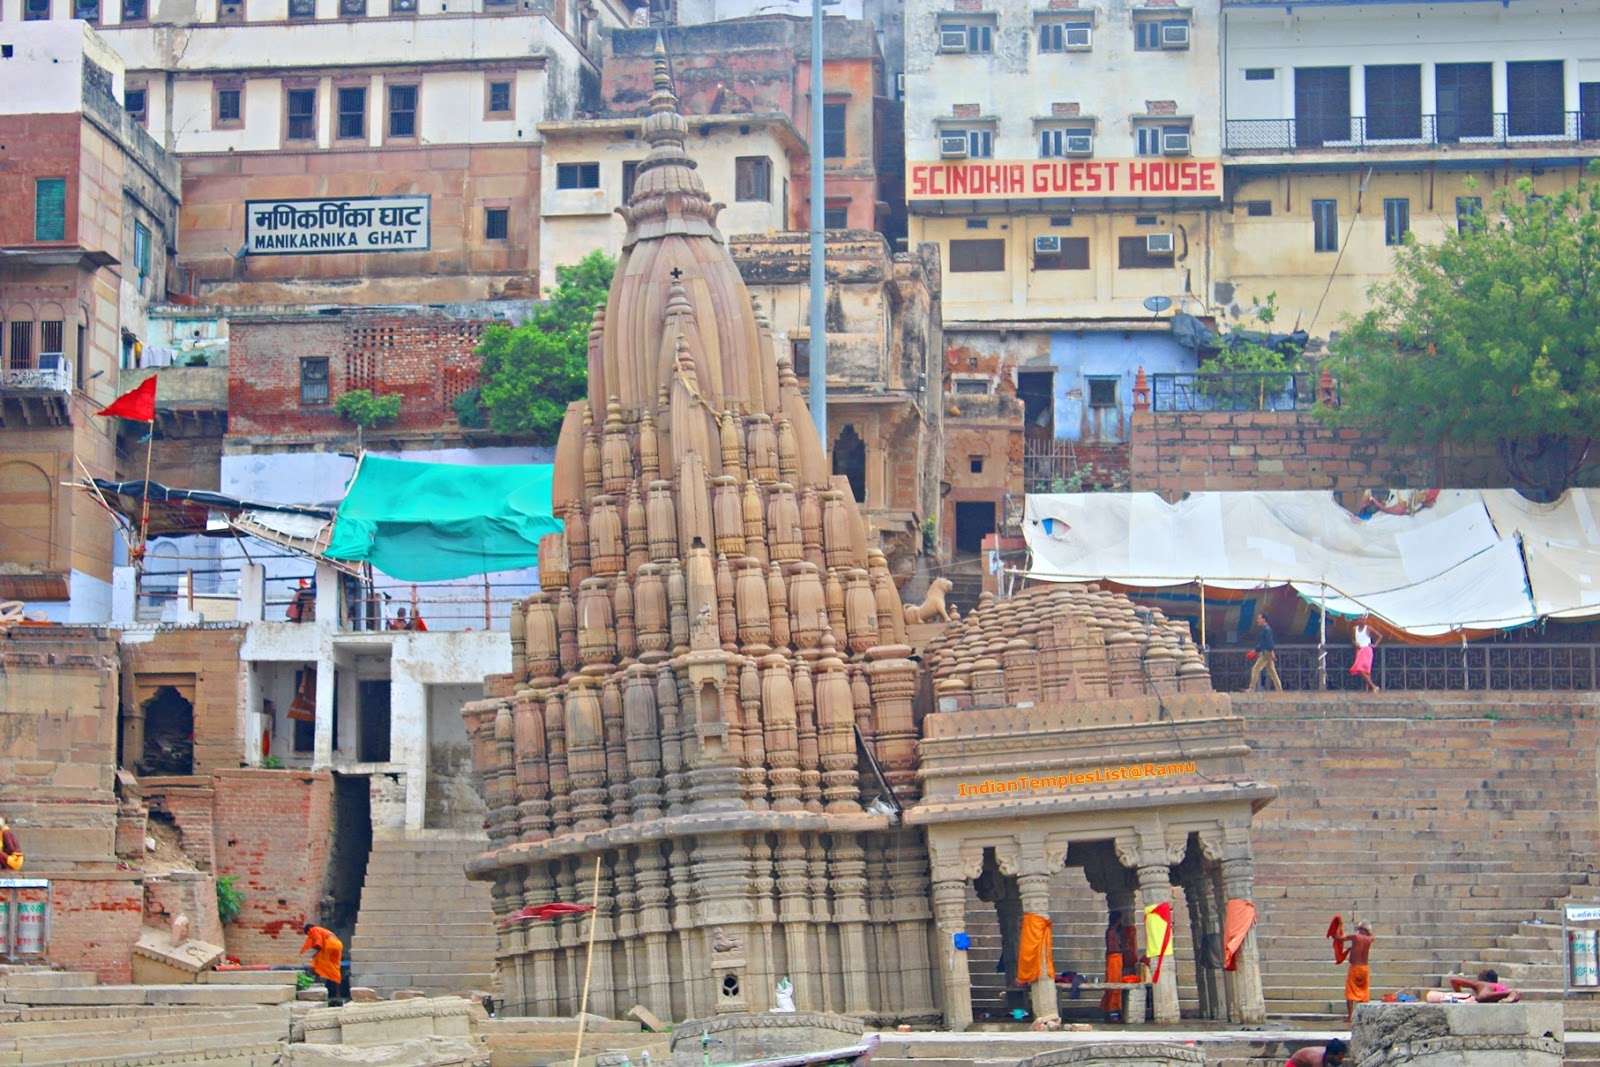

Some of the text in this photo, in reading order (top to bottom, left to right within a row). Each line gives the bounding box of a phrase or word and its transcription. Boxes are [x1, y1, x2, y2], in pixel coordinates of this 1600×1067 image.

[912, 162, 1216, 195] SCINDHIA GUEST HOUSE
[254, 202, 424, 230] मणिकर्णिका घाट
[255, 230, 417, 249] MANIKARNIKA GHAT
